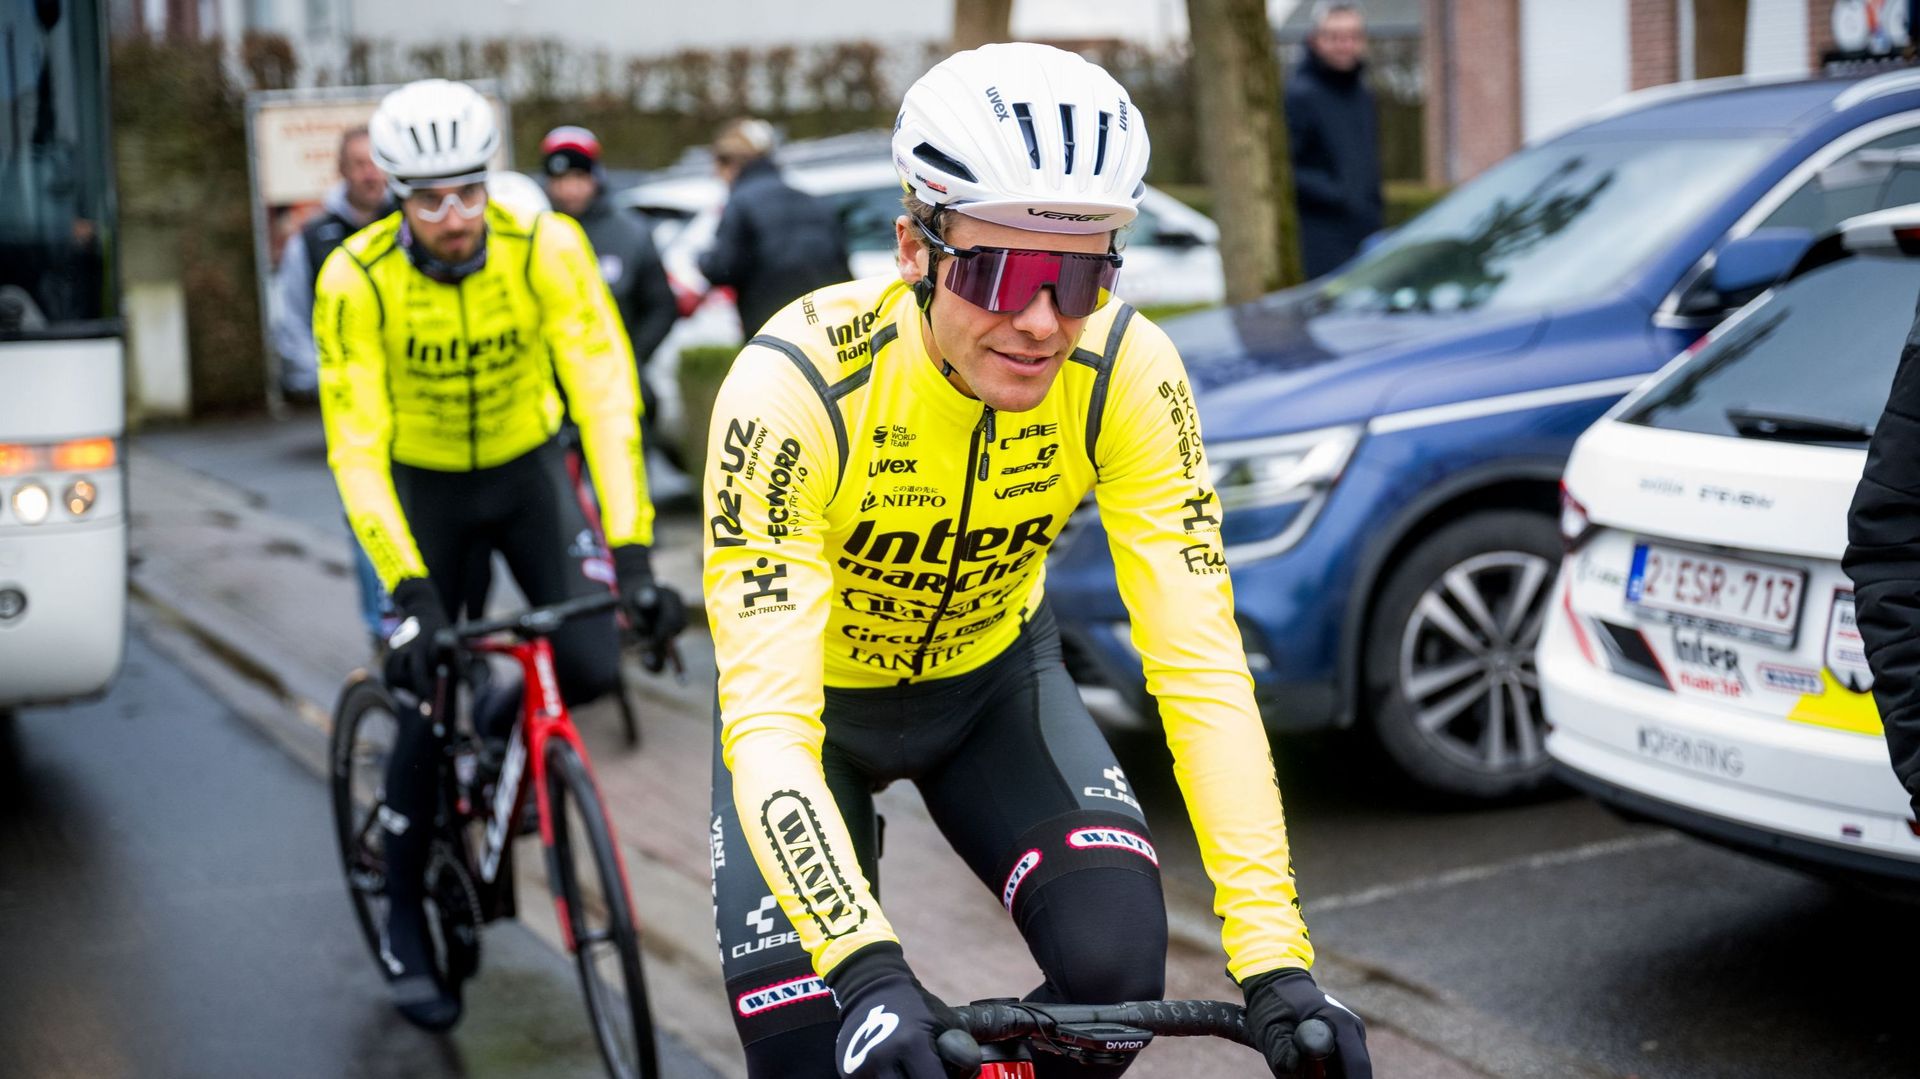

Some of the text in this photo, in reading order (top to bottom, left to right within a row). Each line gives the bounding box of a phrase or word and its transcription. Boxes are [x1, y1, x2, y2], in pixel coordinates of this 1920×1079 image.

[985, 86, 1010, 122] uvex
[1118, 98, 1128, 132] uvex
[1027, 207, 1116, 222] VERGE
[755, 426, 769, 453] NOW
[891, 432, 917, 441] WORLD
[892, 425, 907, 434] UCI
[890, 439, 910, 448] TEAM
[868, 458, 919, 478] uvex
[994, 474, 1061, 500] VERGE
[882, 494, 947, 508] NIPPO
[738, 604, 797, 619] VAN THUYNE
[778, 809, 852, 922] WANTY
[732, 930, 800, 959] CUBE
[745, 979, 827, 1009] WANTY
[1106, 1041, 1143, 1050] bryton
